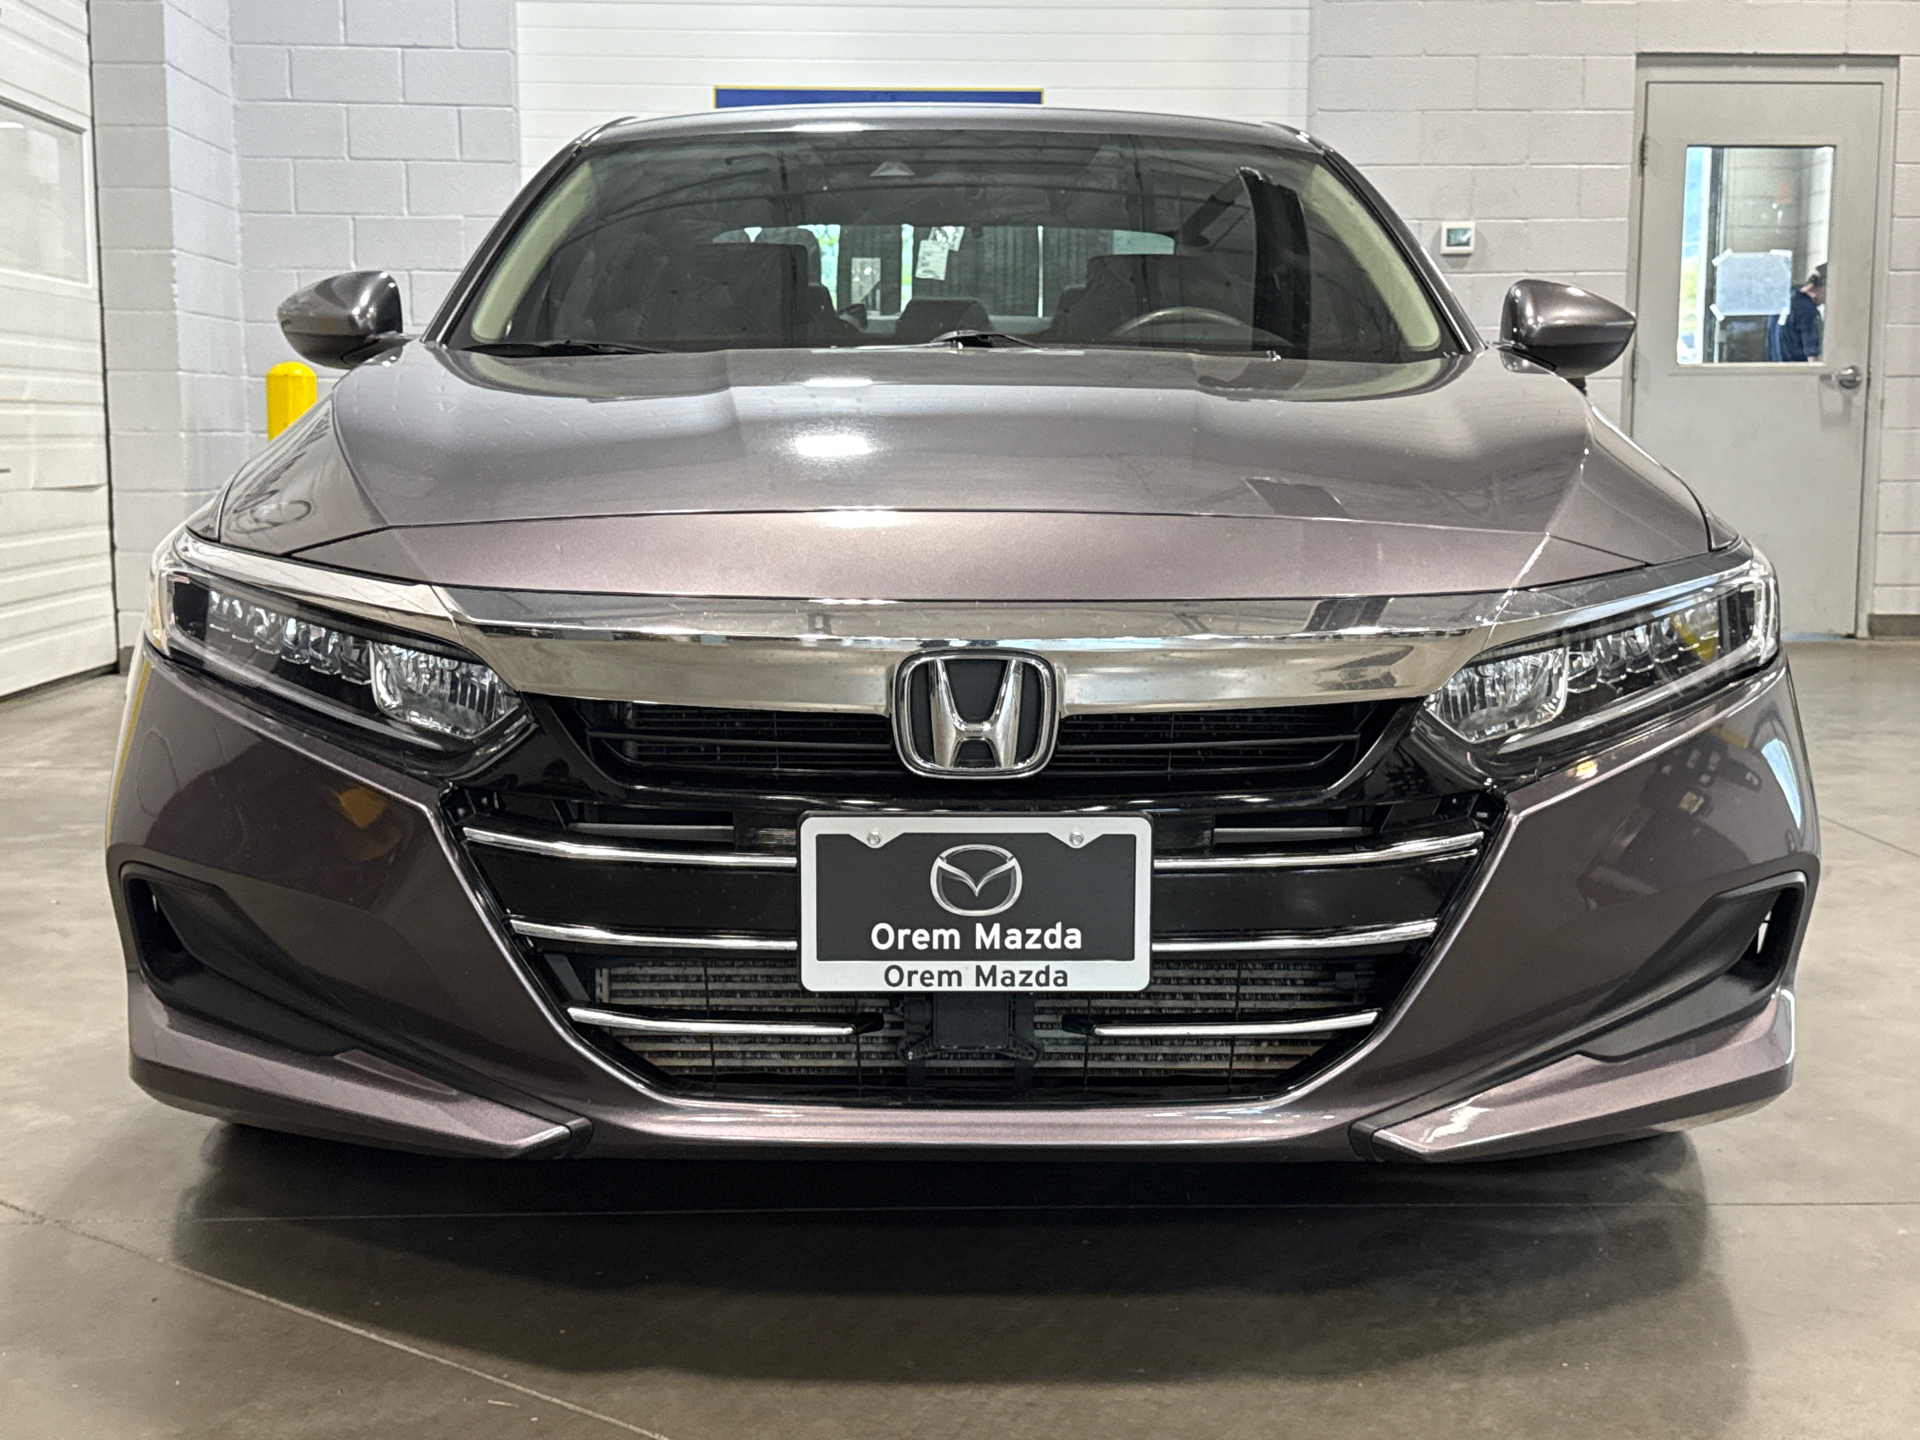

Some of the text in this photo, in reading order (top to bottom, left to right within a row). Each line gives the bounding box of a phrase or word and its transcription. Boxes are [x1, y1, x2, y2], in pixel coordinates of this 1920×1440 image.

[871, 921, 1082, 950] Orem Mazda
[884, 964, 1068, 988] Orem Mazda
